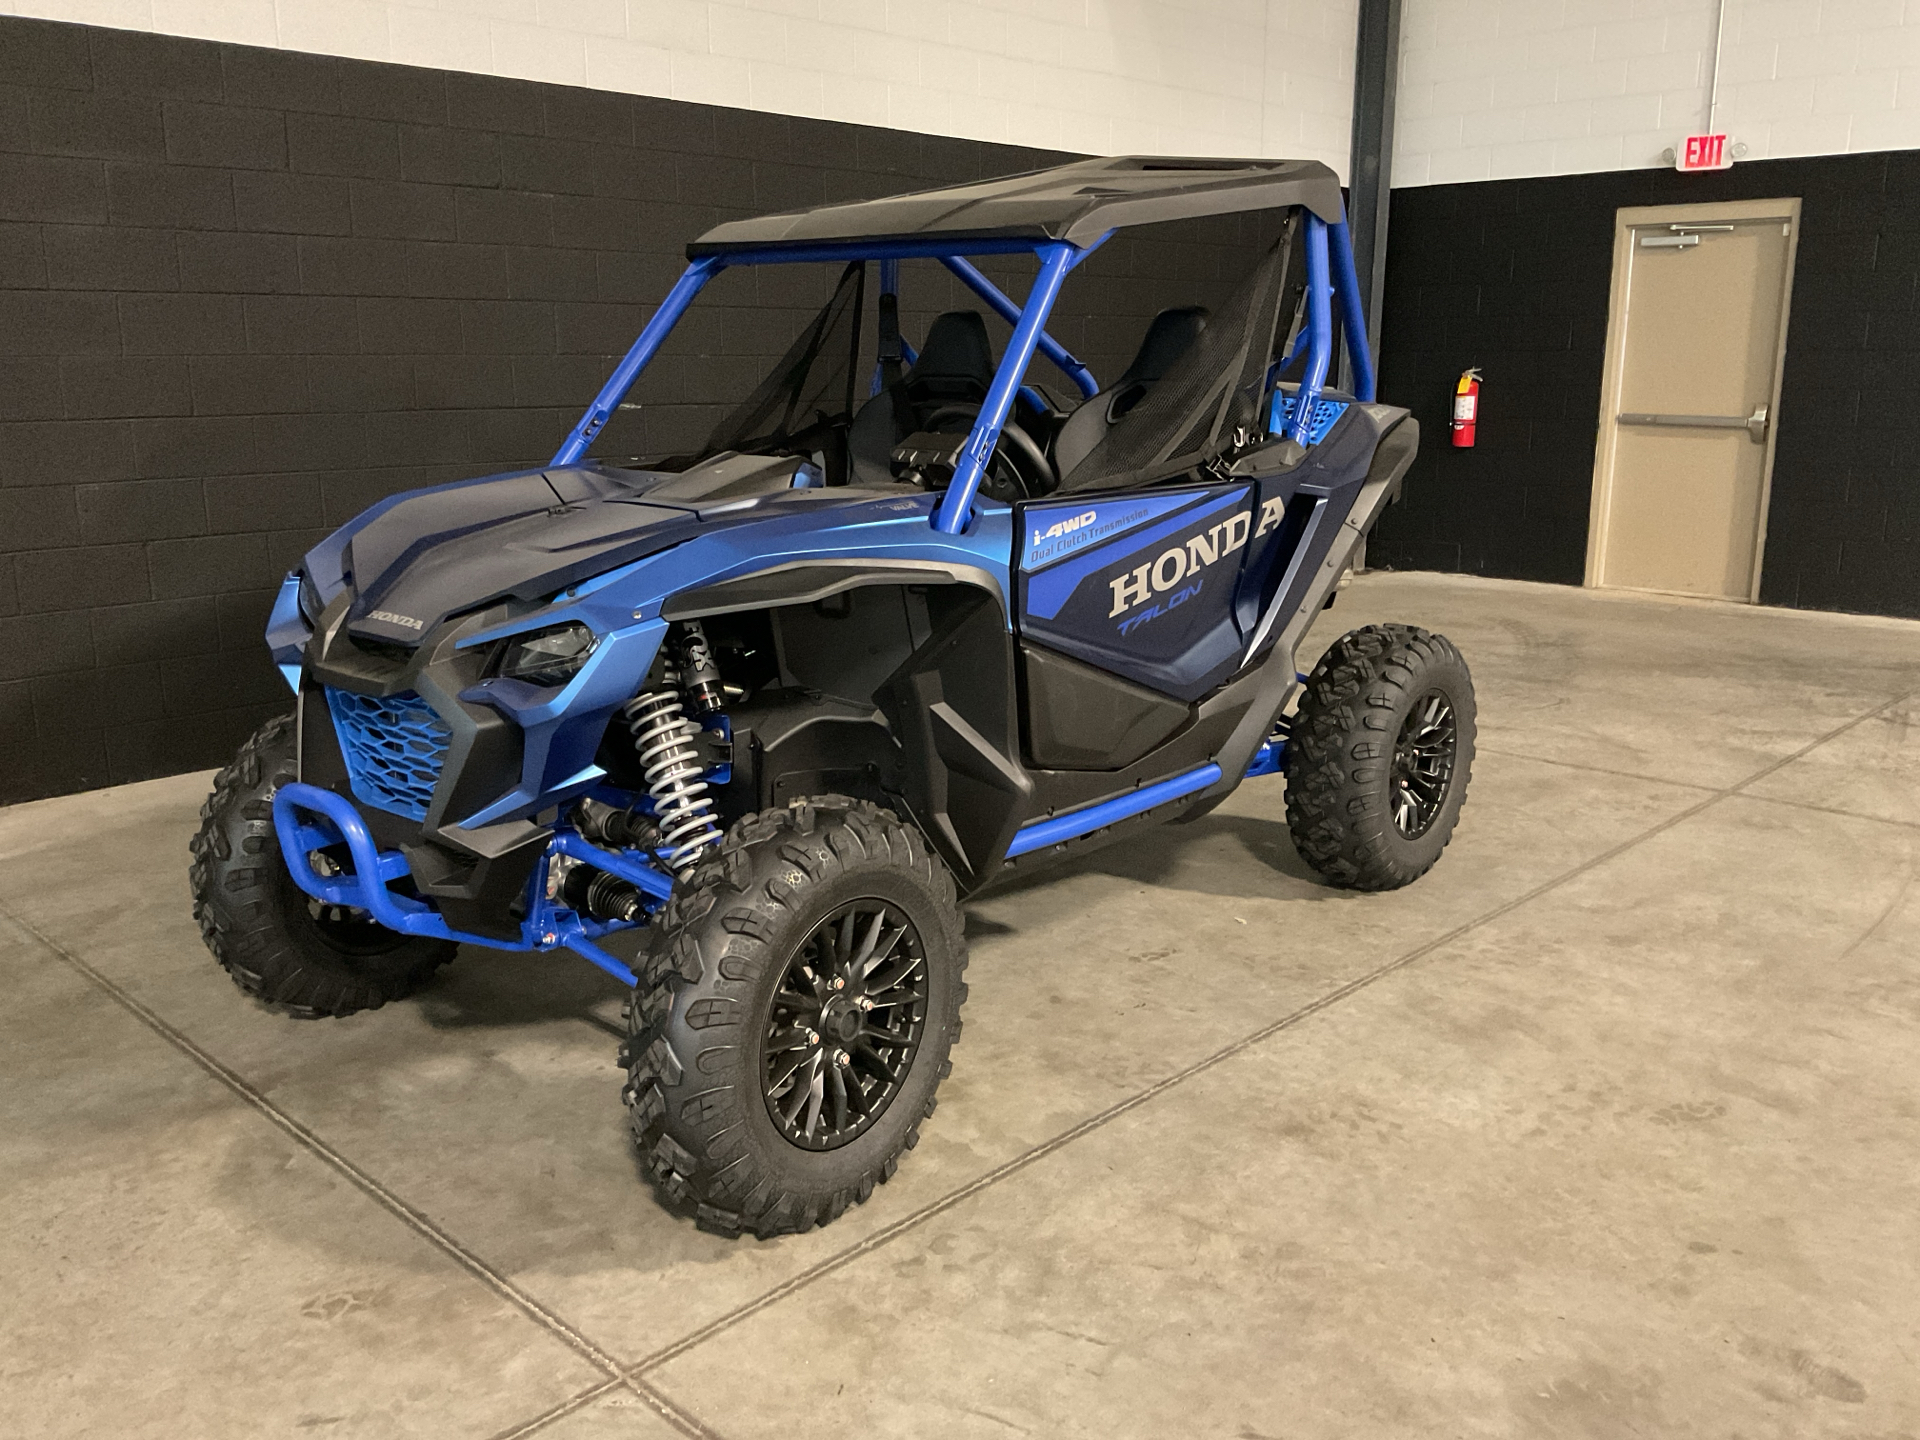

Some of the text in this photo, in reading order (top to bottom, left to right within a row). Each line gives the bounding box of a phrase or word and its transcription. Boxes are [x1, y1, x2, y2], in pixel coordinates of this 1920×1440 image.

[1685, 134, 1727, 168] EXIT
[1031, 508, 1149, 563] Dual Clutch Transmission
[1034, 510, 1097, 547] i-4WD
[1108, 496, 1286, 619] HONDA
[366, 609, 424, 631] HONDA
[1117, 579, 1203, 637] TALON
